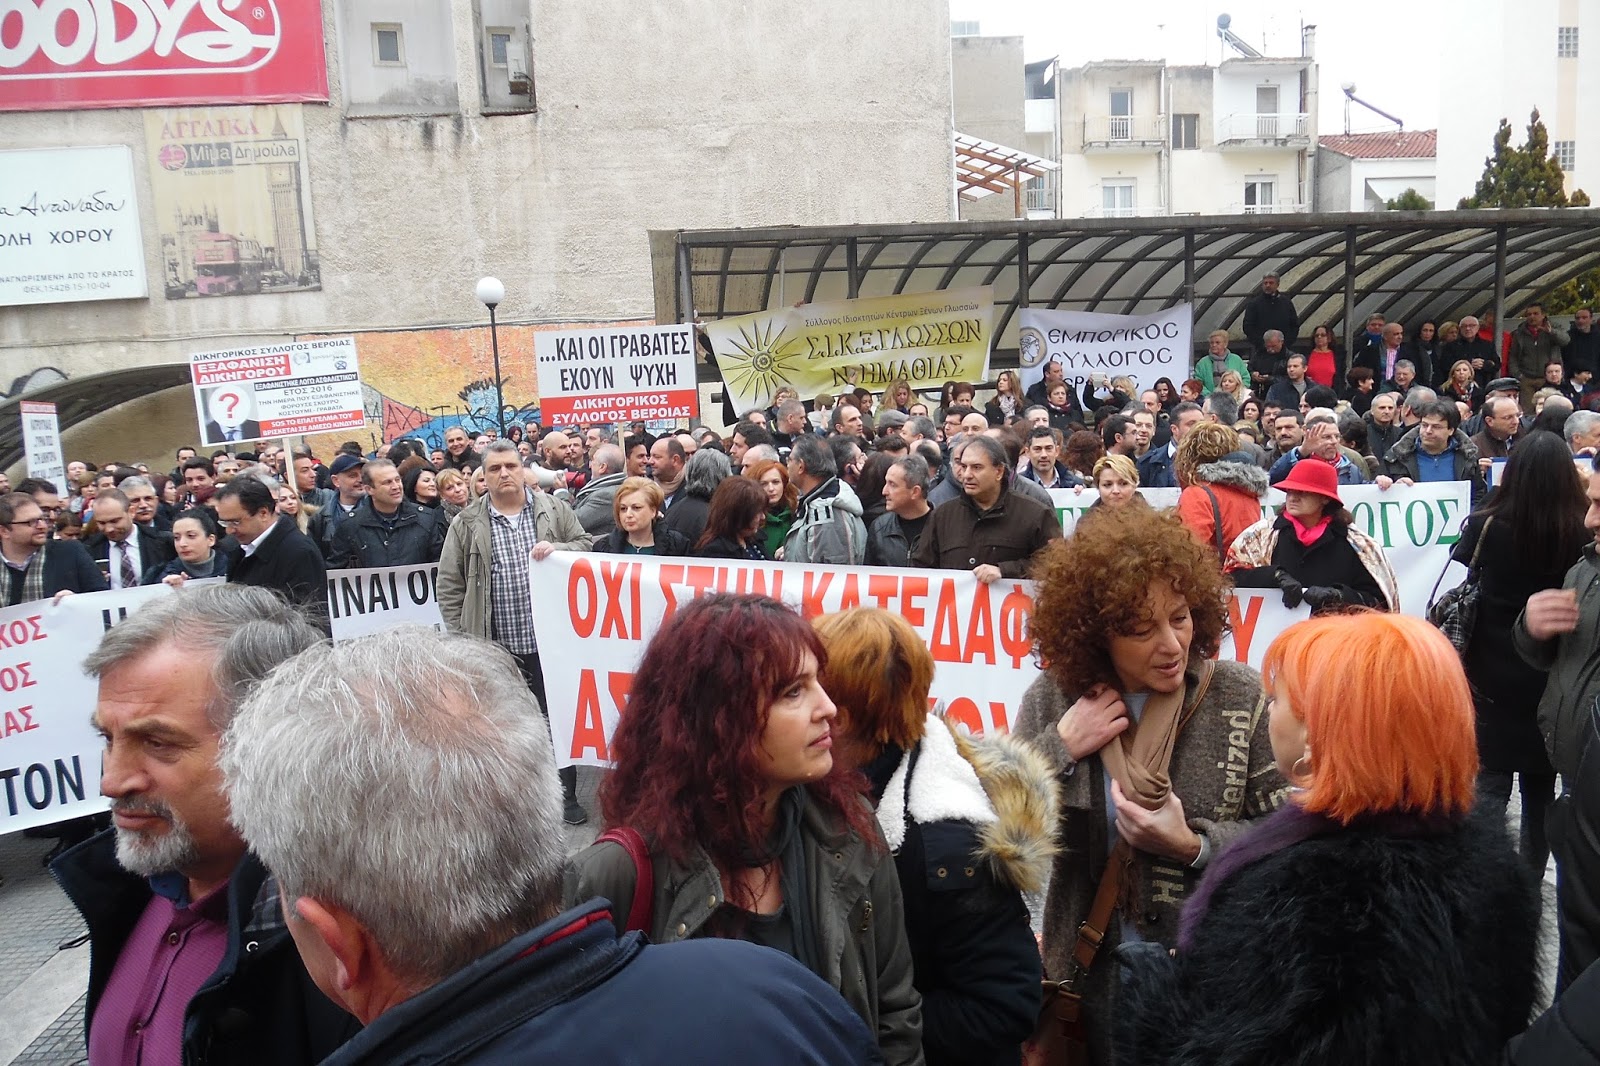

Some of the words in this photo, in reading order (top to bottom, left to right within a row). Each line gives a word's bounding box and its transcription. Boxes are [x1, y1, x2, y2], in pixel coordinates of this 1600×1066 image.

[161, 119, 260, 139] ΑΓΓΛΙΚΑ
[235, 143, 297, 162] Δημούλα
[49, 229, 113, 244] ΧΟΡΟΥ
[67, 272, 85, 280] ΑΠΟ
[87, 271, 99, 279] ΤΟ
[101, 269, 135, 278] ΚΡΑΤΟΣ
[805, 316, 842, 327] Σύλλογος
[842, 312, 884, 324] Ιδιοκτητών
[886, 309, 918, 321] Κέντρων
[919, 306, 943, 316] Ξένων
[944, 302, 979, 312] Γλωσσών
[193, 348, 258, 361] ΔΙΚΗΓΟΡΙΚΟΣ
[260, 343, 309, 355] ΣΥΛΛΟΓΟΣ
[311, 339, 351, 349] ΒΕΡΟΙΑΣ
[588, 335, 606, 360] ΟΙ
[610, 331, 691, 358] ΓΡΑΒΑΤΕΣ
[198, 355, 286, 373] ΕΞΑΦΑΝΙΣΗ
[860, 354, 965, 384] ΗΜΑΘΙΑΣ
[200, 366, 286, 384] ΔΙΚΗΓΟΡΟΥ
[255, 380, 299, 390] ΕΞΑΦΑΝΙΣΤΗΚΕ
[299, 377, 315, 386] ΛΟΓΩ
[315, 373, 357, 384] ΑΣΦΑΛΙΣΤΙΚΟΥ
[560, 366, 614, 391] ΕΧΟΥΝ
[630, 362, 677, 387] ΨΥΧΗ
[283, 387, 308, 396] ΕΤΟΣ
[311, 385, 333, 393] 2016
[311, 390, 359, 400] ΕΞΑΦΑΝΙΣΤΗΚΕ
[278, 407, 312, 417] ΚΟΣΤΟΥΜΙ
[316, 404, 343, 413] ΓΡΑΒΑΤΑ
[281, 402, 312, 410] ΦΟΡΟΥΣΕ
[313, 399, 339, 407] ΣΚΟΥΡΟ
[572, 394, 668, 410] ΔΙΚΗΓΟΡΙΚΟΣ
[297, 414, 338, 424] ΕΠΑΓΓΕΛΜΑ
[552, 409, 627, 424] ΣΥΛΛΟΓΟΣ
[631, 406, 691, 419] ΒΕΡΟΙΑΣ
[262, 427, 298, 436] ΒΡΙΣΚΕΤΑΙ
[307, 422, 332, 431] ΑΜΕΣΟ
[332, 419, 364, 428] ΚΙΝΔΥΝΟ
[567, 557, 643, 640] ΟΧΙ
